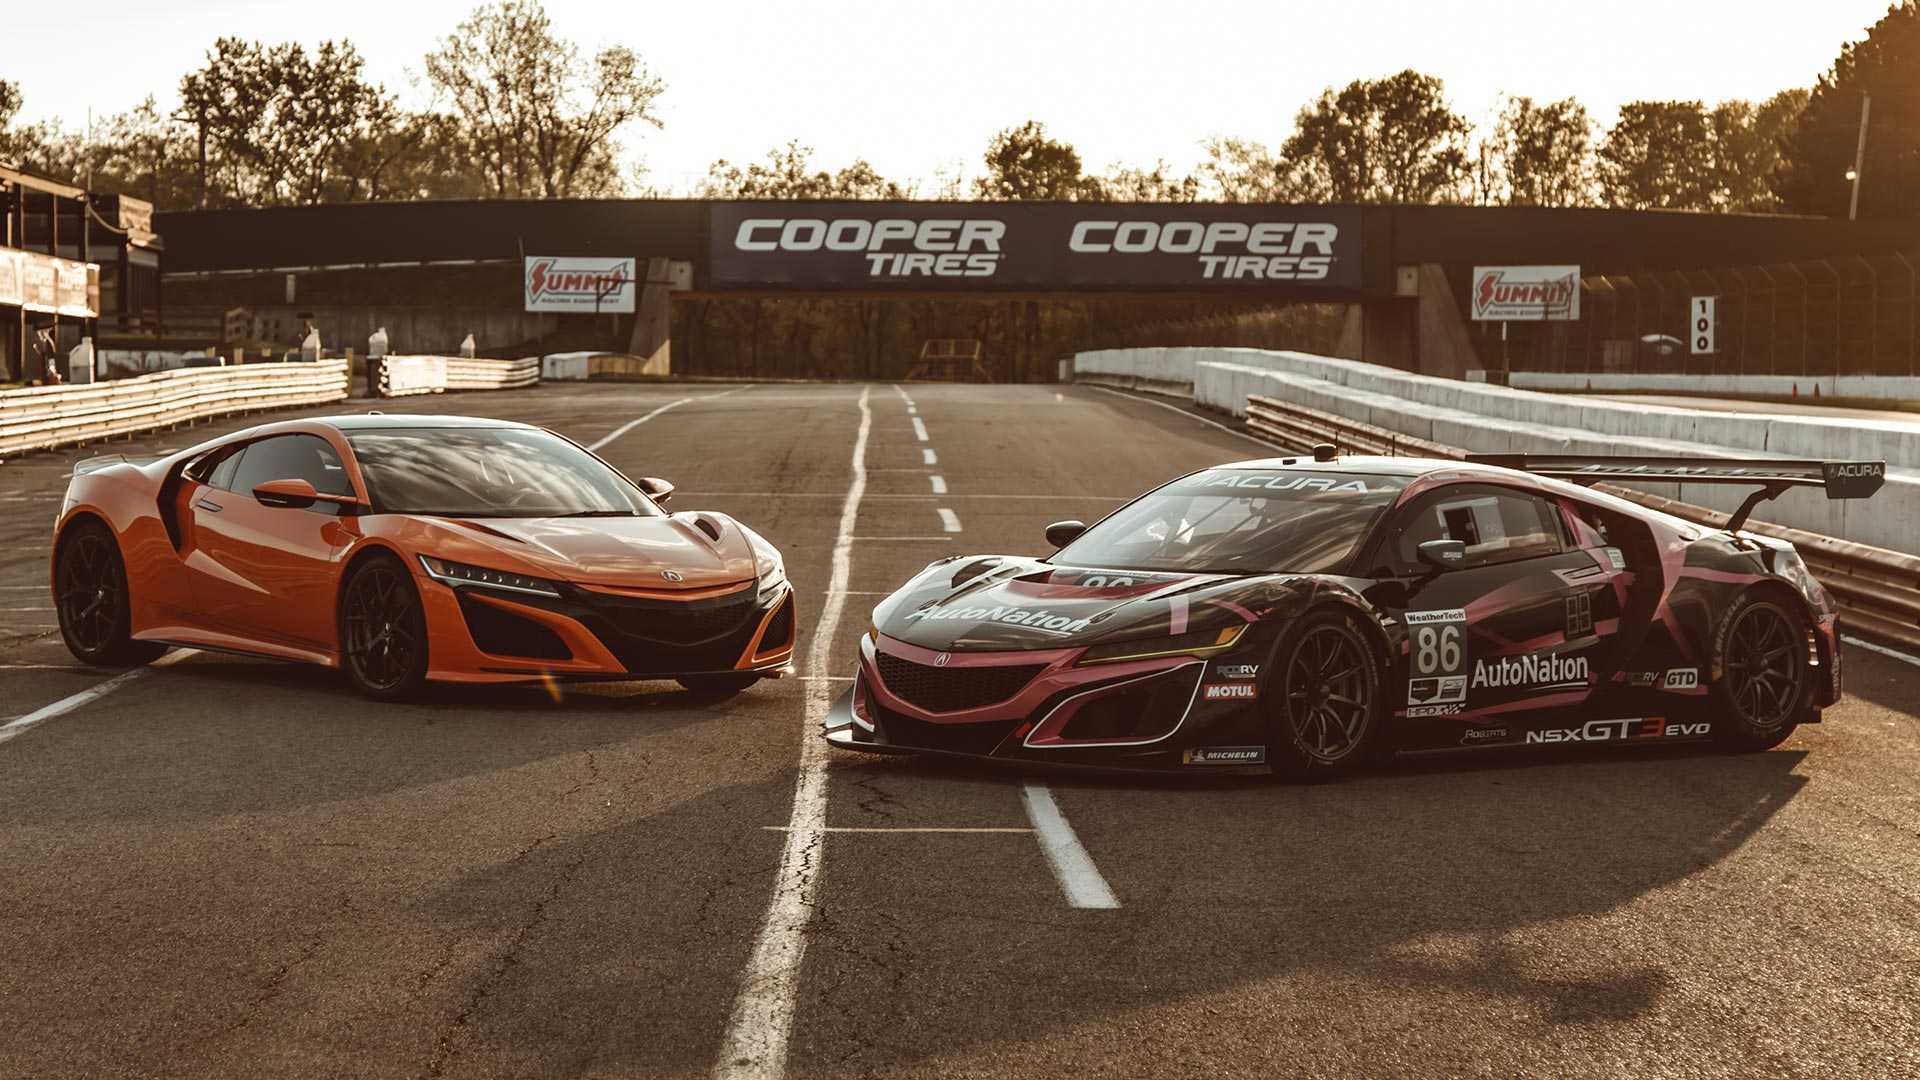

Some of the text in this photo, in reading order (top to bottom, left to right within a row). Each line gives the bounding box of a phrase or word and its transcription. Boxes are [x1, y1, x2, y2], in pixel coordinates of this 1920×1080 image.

[735, 219, 1006, 251] COOPER
[1069, 221, 1338, 254] COOPER
[866, 253, 1000, 276] TIRES
[1198, 256, 1332, 279] TIRES
[530, 261, 624, 297] SUMMIT
[1477, 274, 1571, 307] SUMMIT
[1697, 300, 1709, 351] 100
[1837, 464, 1882, 477] ACURA
[1202, 475, 1369, 494] ACURA
[904, 605, 1091, 633] AutoNation
[1407, 611, 1465, 622] WeatherTech
[1418, 625, 1460, 674] 86
[1471, 652, 1589, 689] AutoNation
[1666, 671, 1696, 686] GTD
[1207, 685, 1255, 698] MOTUL
[1207, 751, 1259, 759] MICHELIN
